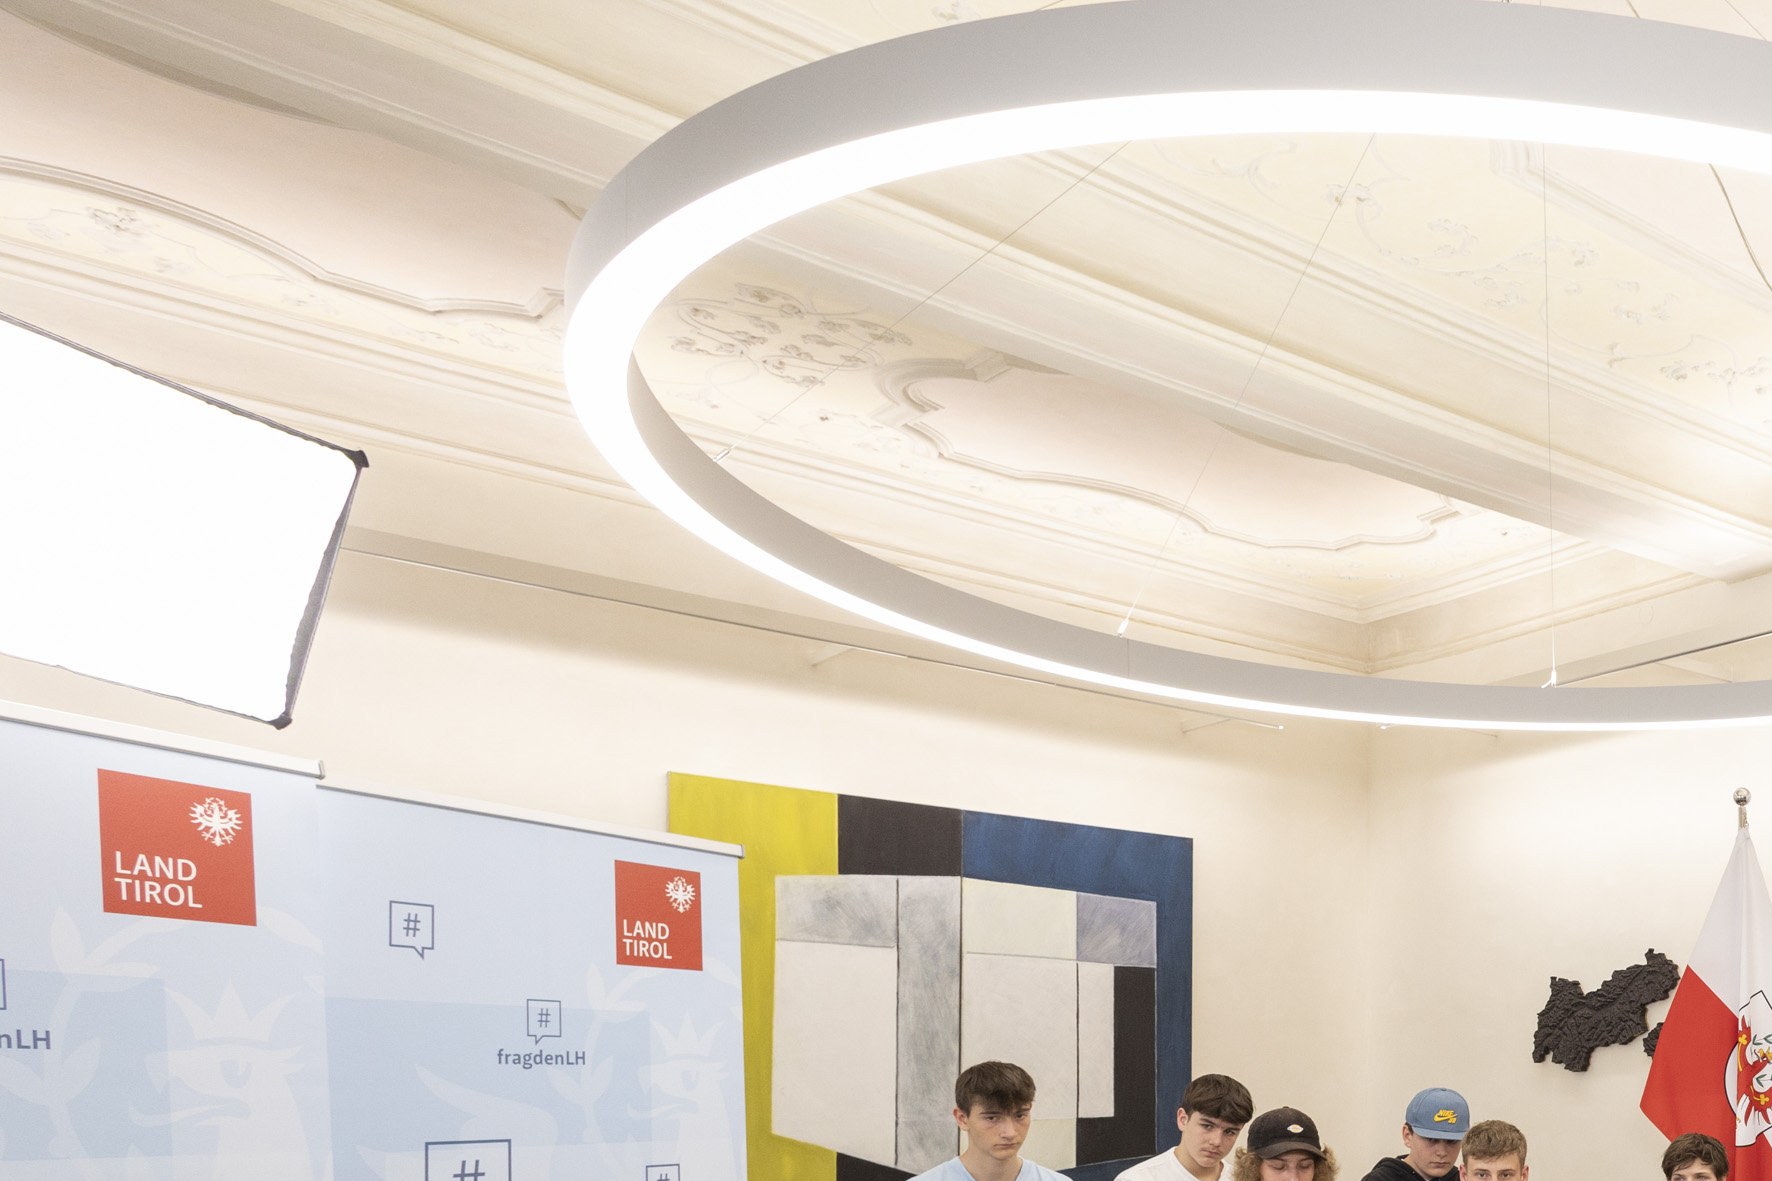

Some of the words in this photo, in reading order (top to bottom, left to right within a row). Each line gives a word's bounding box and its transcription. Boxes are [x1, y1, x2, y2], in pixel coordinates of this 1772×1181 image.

[115, 850, 197, 881] LAND
[113, 877, 203, 908] TIROL
[623, 919, 670, 940] LAND
[622, 938, 673, 960] TIROL
[497, 1048, 587, 1070] fragdenLH
